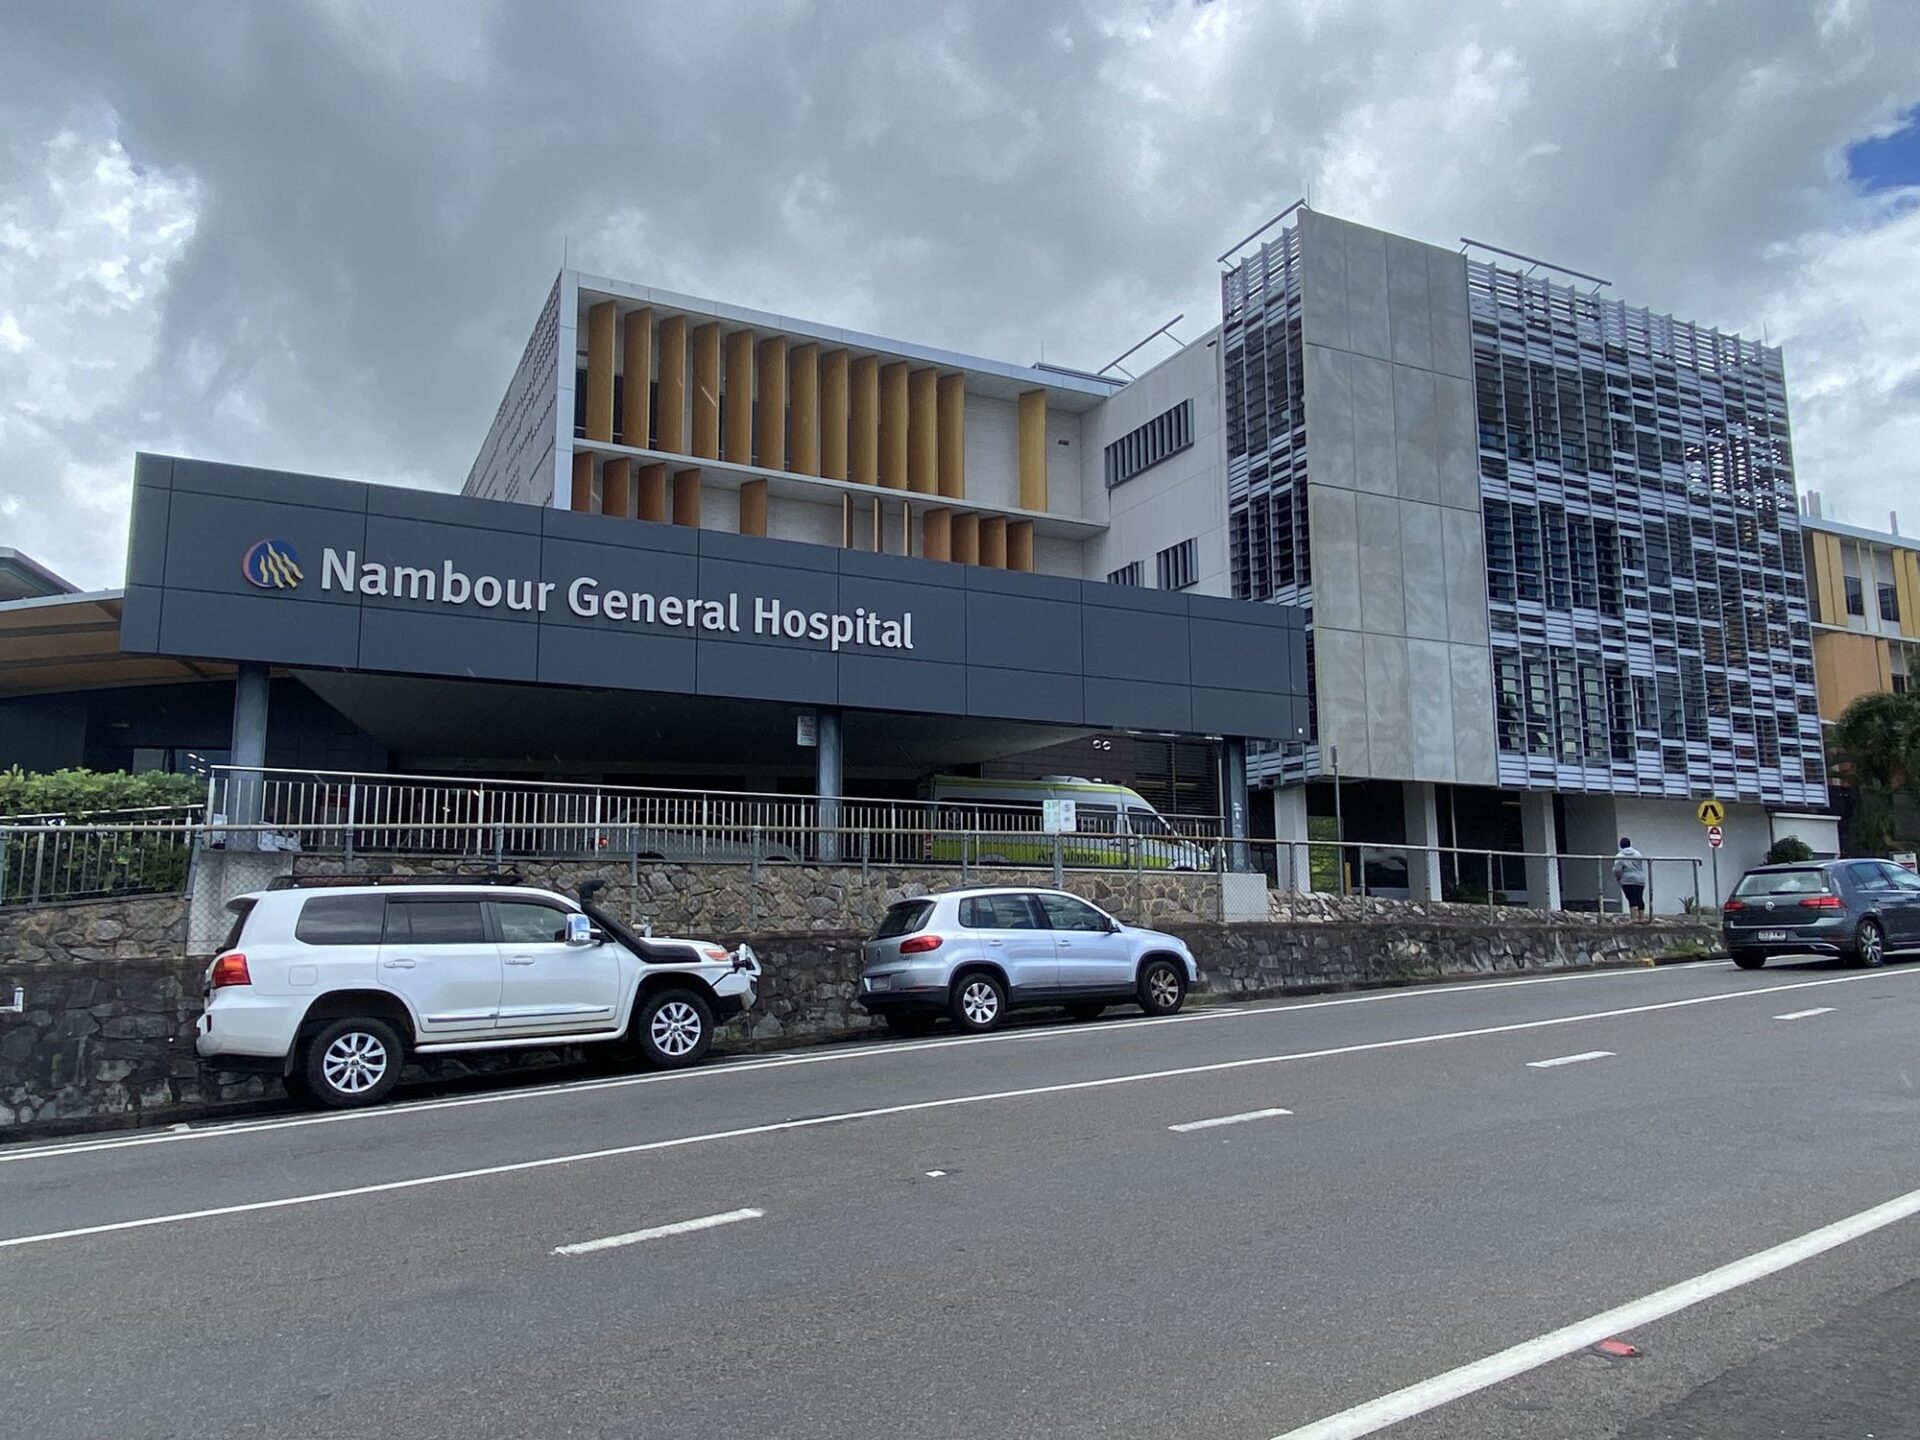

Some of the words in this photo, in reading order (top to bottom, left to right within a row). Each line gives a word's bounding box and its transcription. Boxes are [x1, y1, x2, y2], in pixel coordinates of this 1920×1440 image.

[321, 548, 556, 611] Nambour
[568, 577, 740, 632] General
[754, 597, 914, 651] Hospital
[1038, 848, 1100, 864] Amulance
